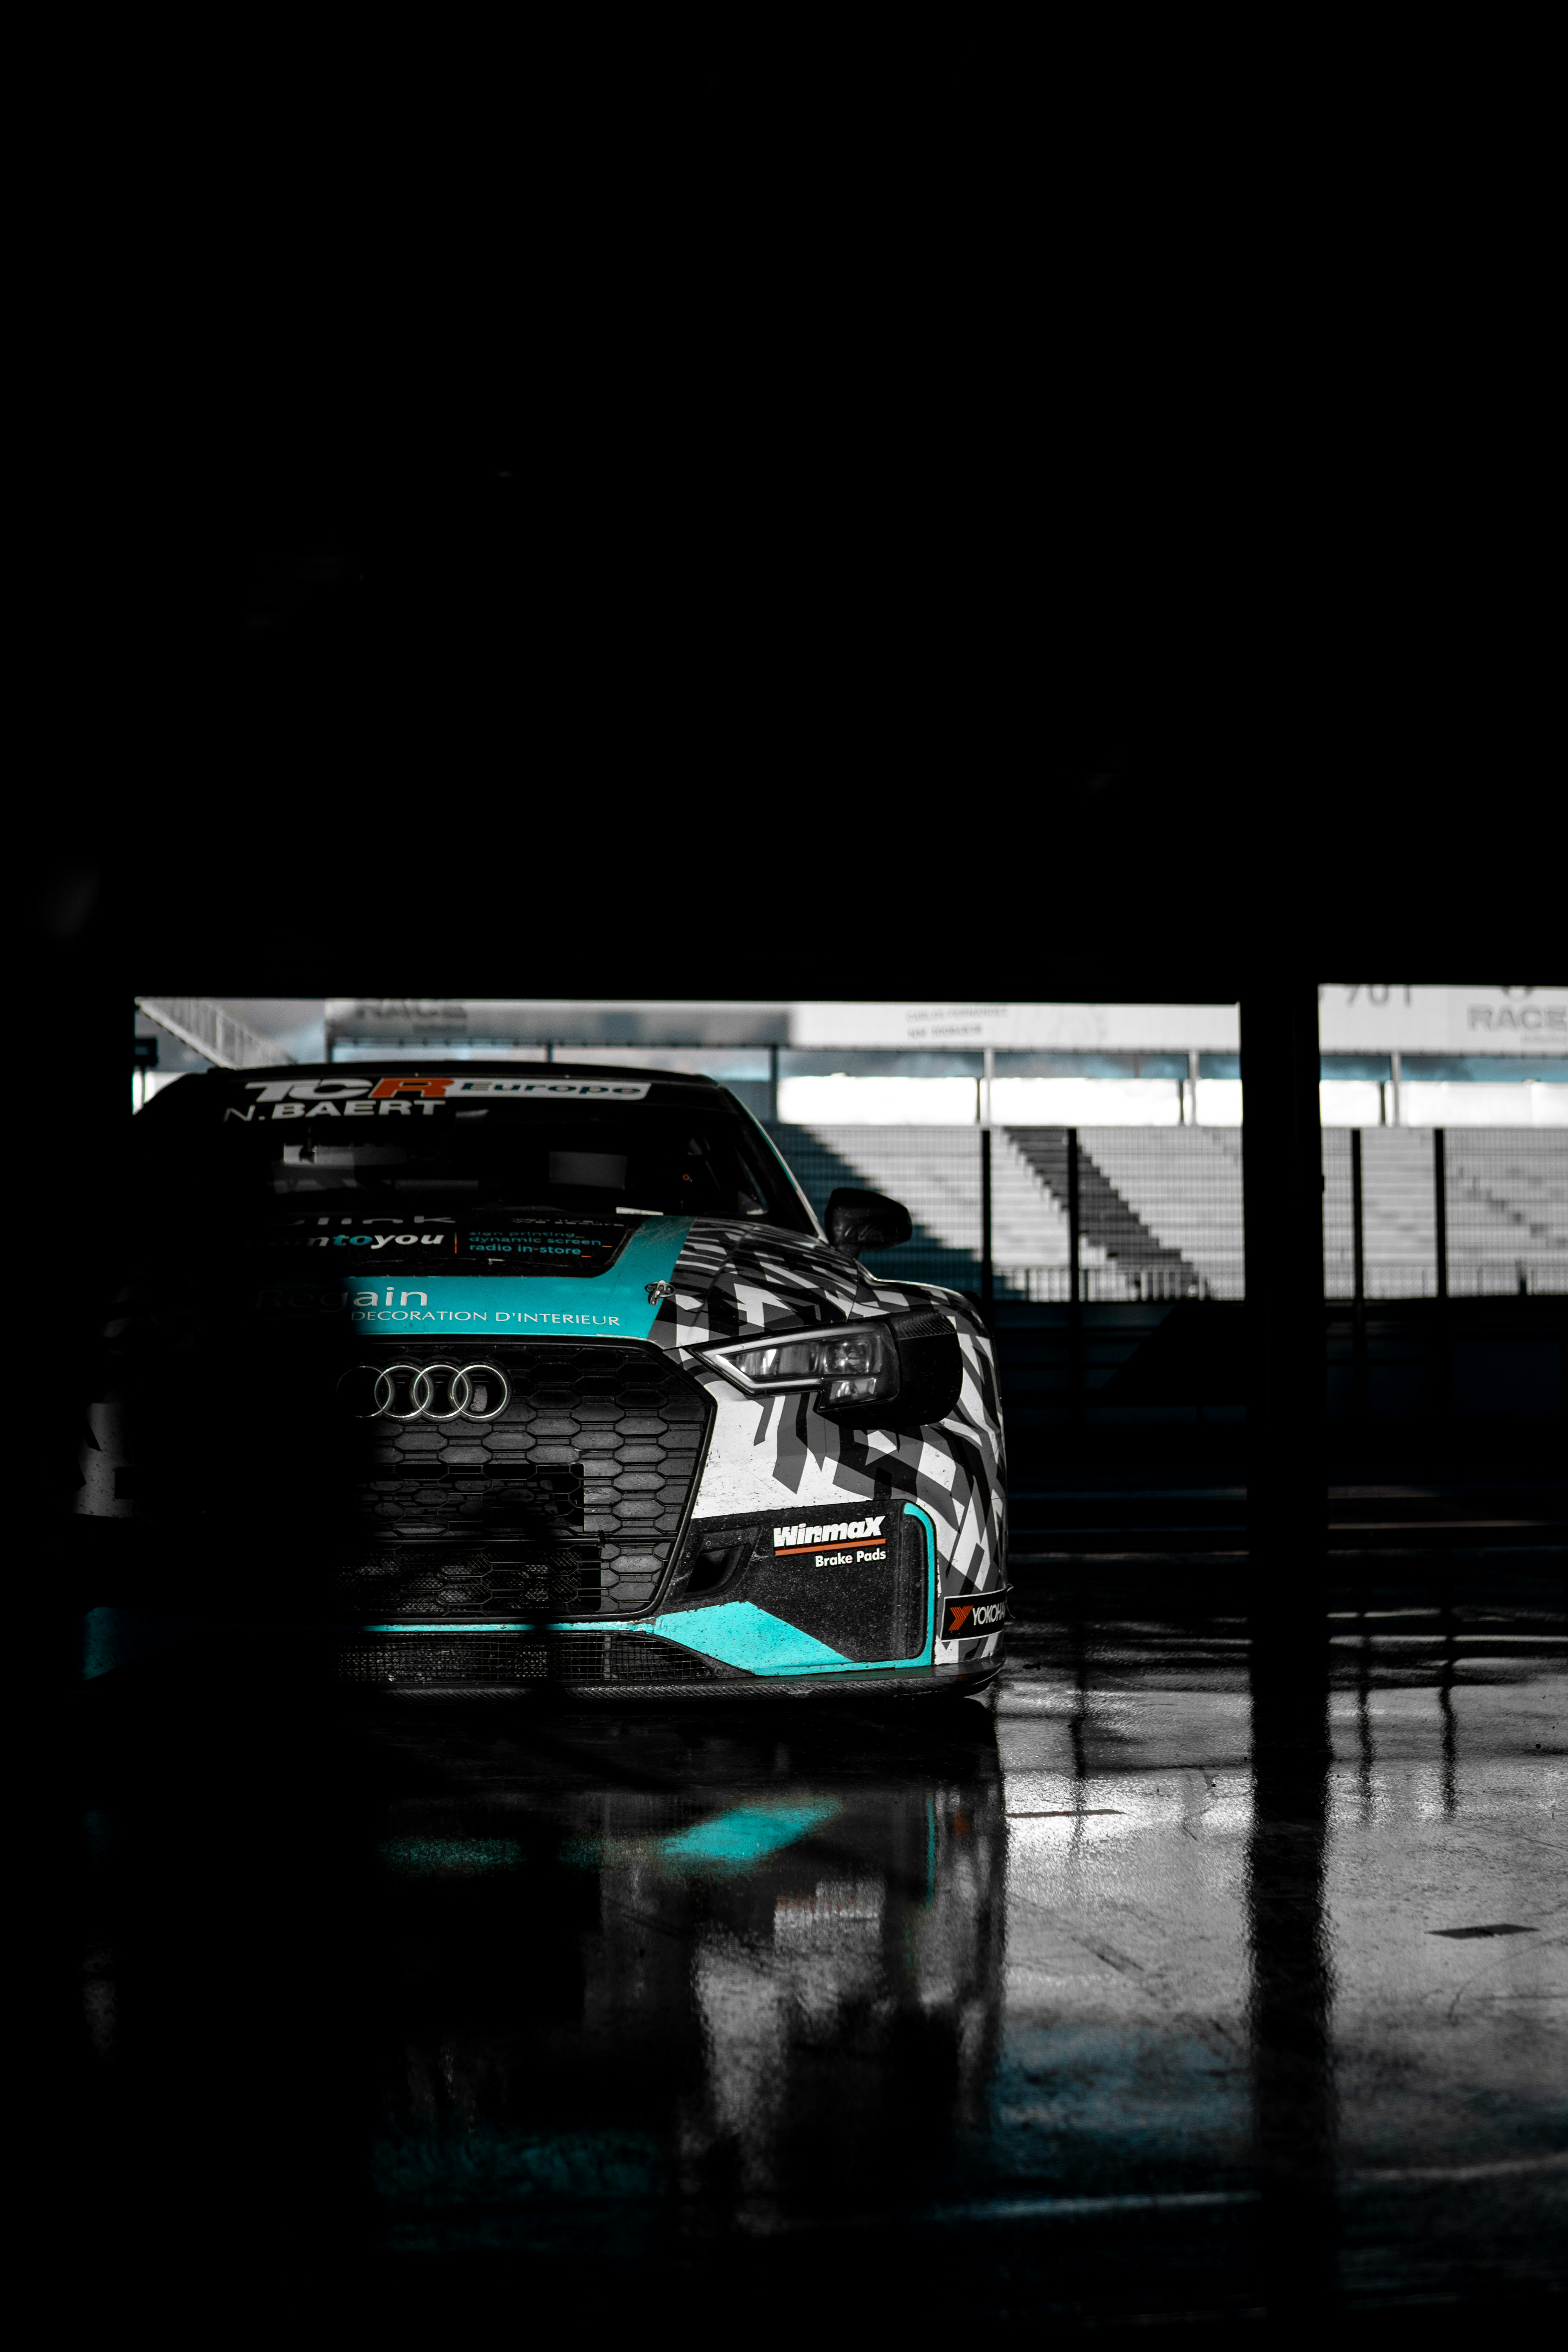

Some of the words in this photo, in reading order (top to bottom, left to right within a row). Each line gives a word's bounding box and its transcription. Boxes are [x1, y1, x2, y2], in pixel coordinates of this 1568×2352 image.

[245, 1078, 453, 1102] TCR
[461, 1082, 641, 1094] Europe
[517, 1244, 581, 1255] in-store
[352, 1311, 487, 1321] DECORATION
[495, 1312, 620, 1326] D'INTERIEUR
[815, 1552, 853, 1567] Brake
[856, 1547, 887, 1563] Pads
